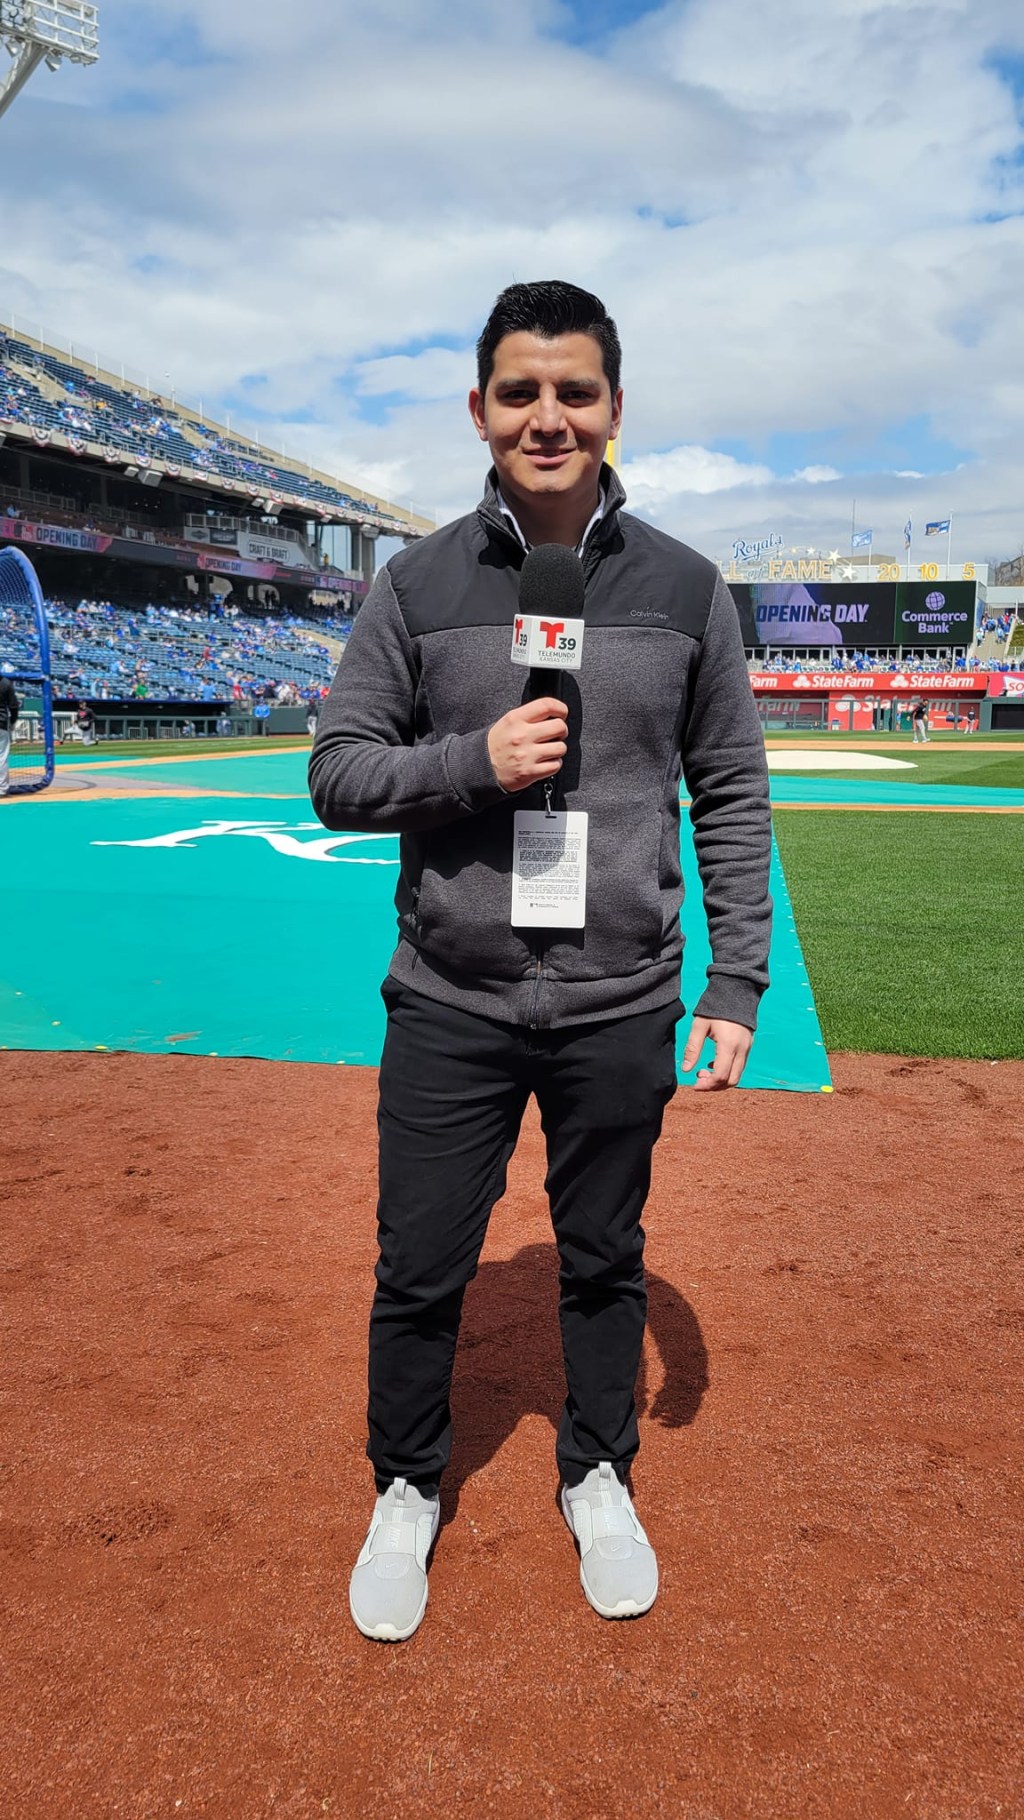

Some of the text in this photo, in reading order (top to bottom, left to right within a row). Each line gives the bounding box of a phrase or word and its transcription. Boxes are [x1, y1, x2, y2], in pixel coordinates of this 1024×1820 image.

[36, 527, 97, 549] OPENING DAY
[732, 532, 783, 561] Royals
[717, 560, 744, 579] LL
[768, 560, 833, 579] FAME
[878, 563, 900, 580] 20
[919, 563, 938, 580] 10
[963, 562, 975, 580] 5
[630, 606, 652, 618] Calvin
[756, 604, 832, 623] OPENING
[901, 610, 968, 622] Commerce
[918, 622, 949, 634] Bank
[558, 637, 577, 650] 39
[538, 650, 576, 659] TELEMUNDO
